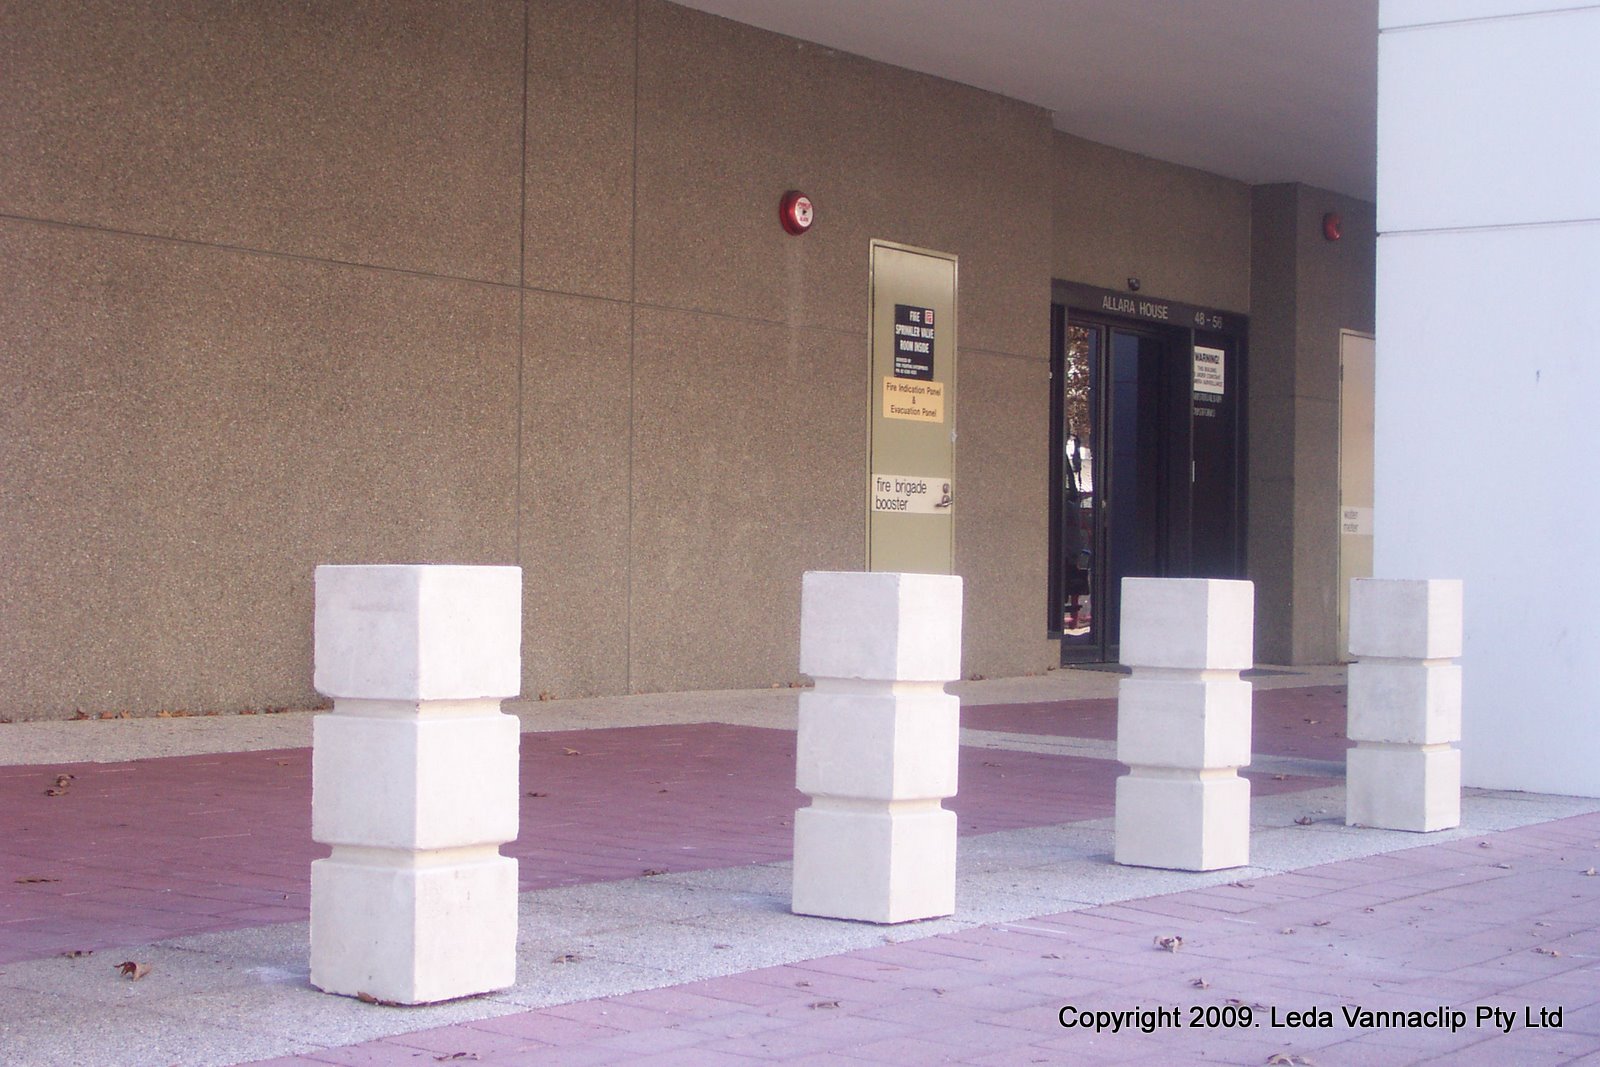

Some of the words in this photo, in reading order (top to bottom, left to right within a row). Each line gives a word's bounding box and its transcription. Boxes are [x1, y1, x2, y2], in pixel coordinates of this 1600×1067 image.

[1102, 295, 1136, 314] ALLARA
[1139, 302, 1168, 319] HOUSE
[909, 310, 920, 322] FIRE
[895, 324, 920, 337] SPRINKLER
[920, 327, 934, 339] VALVE
[900, 340, 914, 352] ROOM
[914, 341, 929, 354] INSIDE
[886, 382, 898, 392] Fire
[898, 384, 926, 395] Indication
[926, 386, 942, 397] Panel
[890, 404, 921, 416] Evacuation
[921, 407, 937, 418] Panel
[877, 477, 891, 492] fire
[895, 479, 927, 497] brigade
[875, 495, 908, 511] booster
